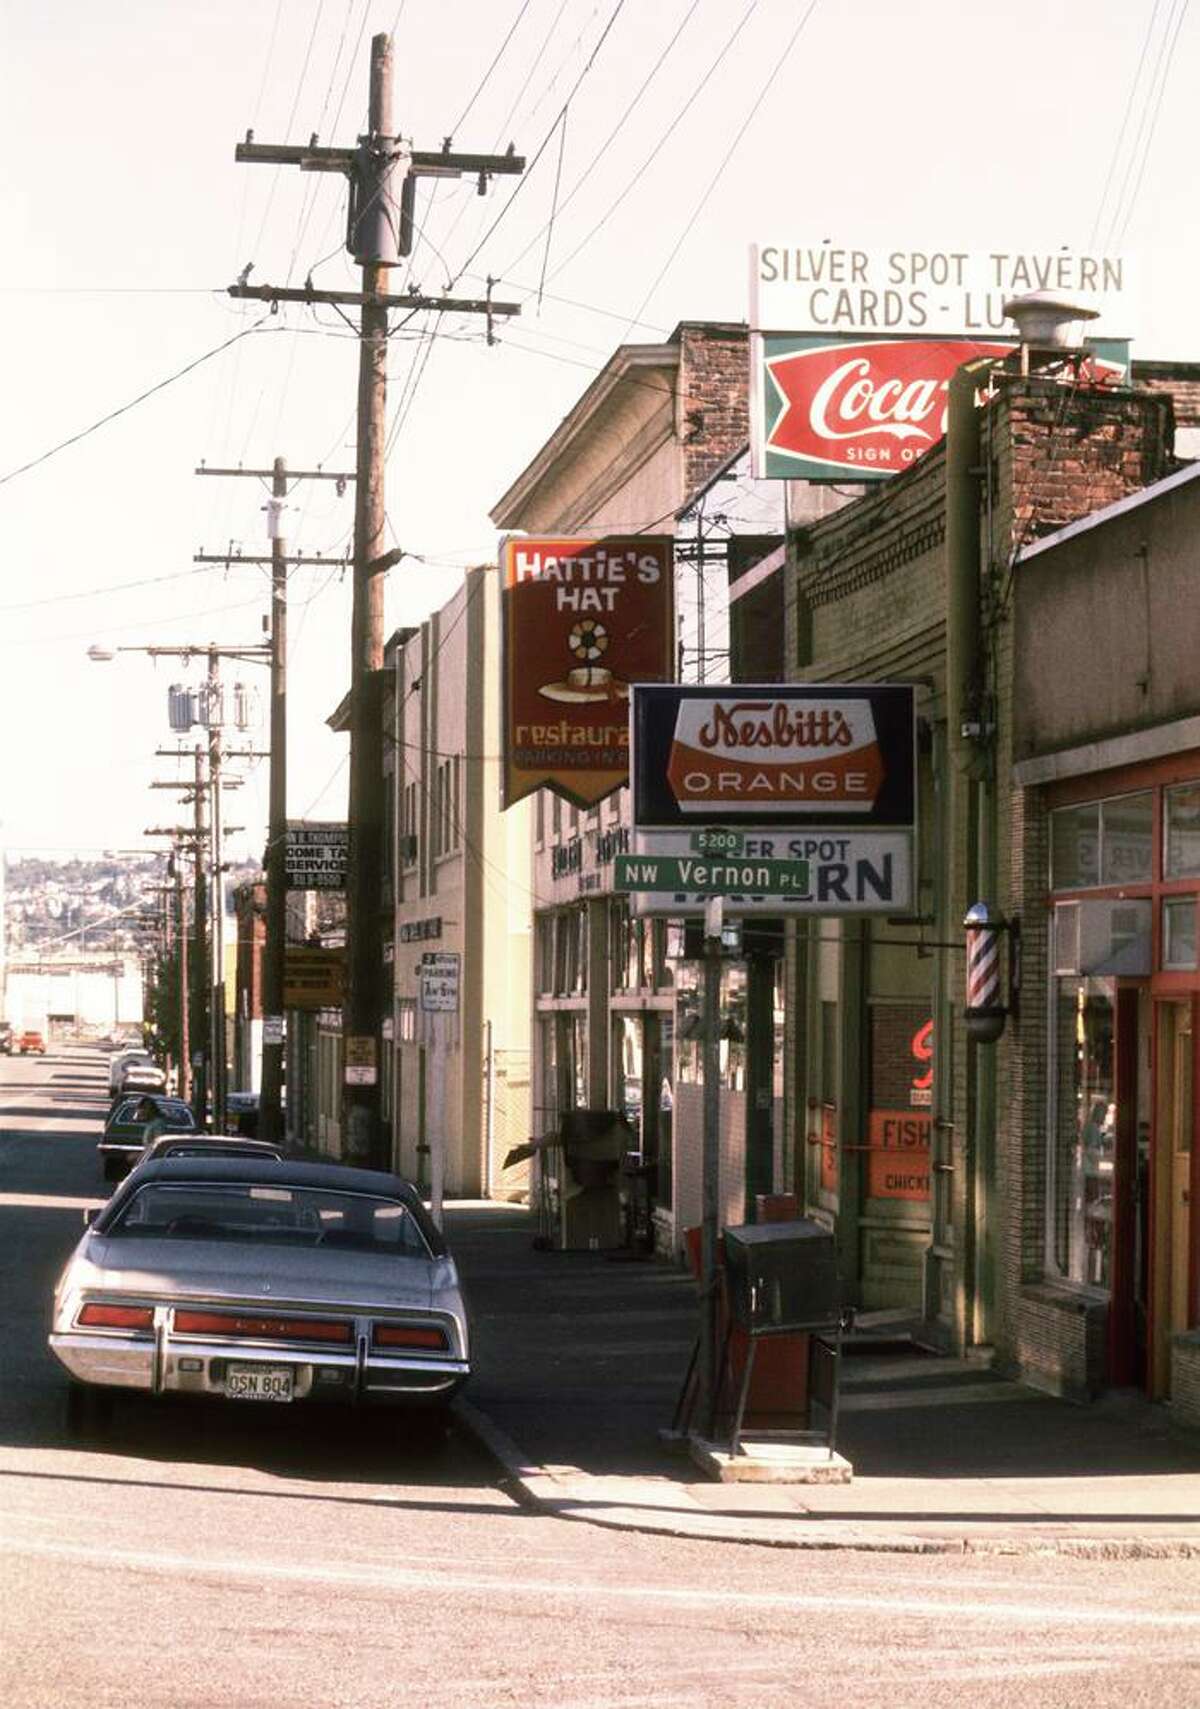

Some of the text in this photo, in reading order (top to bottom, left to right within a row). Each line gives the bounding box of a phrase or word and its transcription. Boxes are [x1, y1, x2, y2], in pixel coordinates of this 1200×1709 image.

[760, 247, 1124, 292] SILVER SPOT TAVERN
[808, 288, 929, 328] CARDS
[965, 292, 1010, 329] LU
[809, 357, 945, 440] Coca
[846, 447, 891, 461] SIGN
[556, 586, 620, 612] HAT
[515, 720, 629, 746] restaura
[699, 702, 855, 748] Nesbitt's
[684, 771, 868, 793] ORANGE
[698, 834, 737, 848] 5200
[789, 840, 851, 861] SPOT
[625, 860, 802, 888] NW Vernon PL
[882, 1119, 931, 1149] FISH
